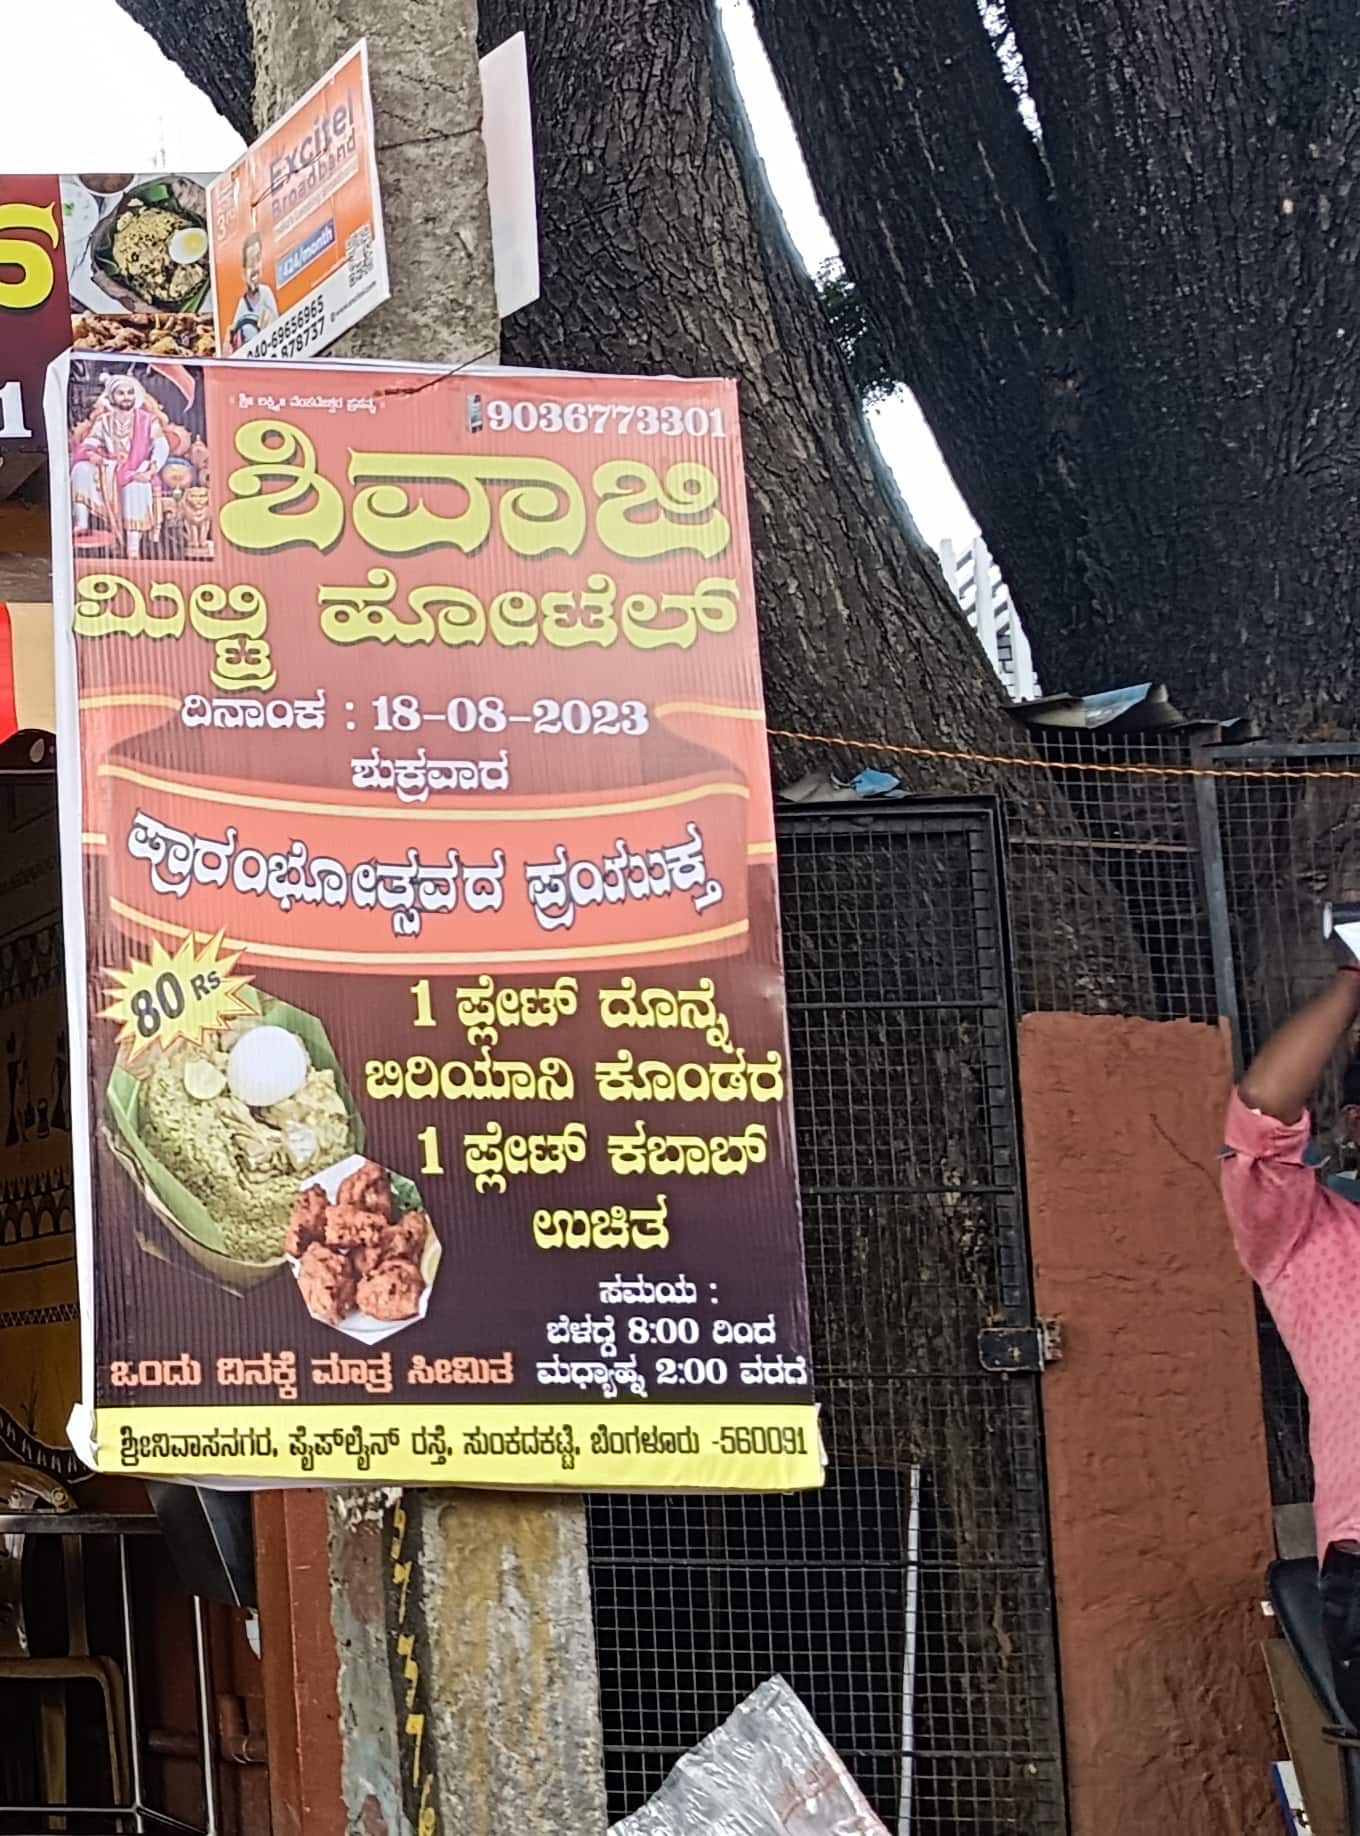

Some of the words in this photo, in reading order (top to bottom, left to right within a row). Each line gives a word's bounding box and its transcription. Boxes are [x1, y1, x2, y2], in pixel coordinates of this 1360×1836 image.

[269, 86, 355, 193] Excitel
[486, 399, 726, 438] 9036773301
[219, 417, 731, 560] ಶಿವಾಜಿ
[73, 573, 277, 691] ಮಿಲ್ಟ್ರಿ
[316, 568, 741, 649] ಹೋಟೆಲ್
[180, 690, 327, 730] ದಿನಾಂಕ
[371, 694, 650, 737] 18-08-2023
[350, 747, 510, 803] ಶುಕ್ರವಾರ
[524, 821, 726, 931] ಪ್ರಯುಕ್ತ
[130, 971, 186, 1038] 80
[189, 970, 222, 1002] Rs
[410, 978, 438, 1028] 1
[598, 976, 736, 1055] ದೊನ್ನೆ
[364, 1045, 575, 1102] ಬಿರಿಯಾನಿ
[594, 1048, 785, 1102] ಕೊಂಡರೆ
[417, 1125, 445, 1177] 1
[607, 1119, 769, 1177] ಕಬಾಬ್
[532, 1193, 670, 1250] ಉಚಿತ
[598, 1273, 698, 1305] ಸಮಯ
[627, 1316, 700, 1345] 8:00
[109, 1352, 202, 1388] ಒಂದು
[215, 1351, 299, 1400] ದಿನಕ್ಕೆ
[310, 1351, 395, 1395] ಮಾತ್ರ
[406, 1351, 515, 1387] ಸೀಮಿತ
[654, 1357, 729, 1385] 2:00
[589, 1423, 700, 1456] ಬೆಂಗಳೂರು
